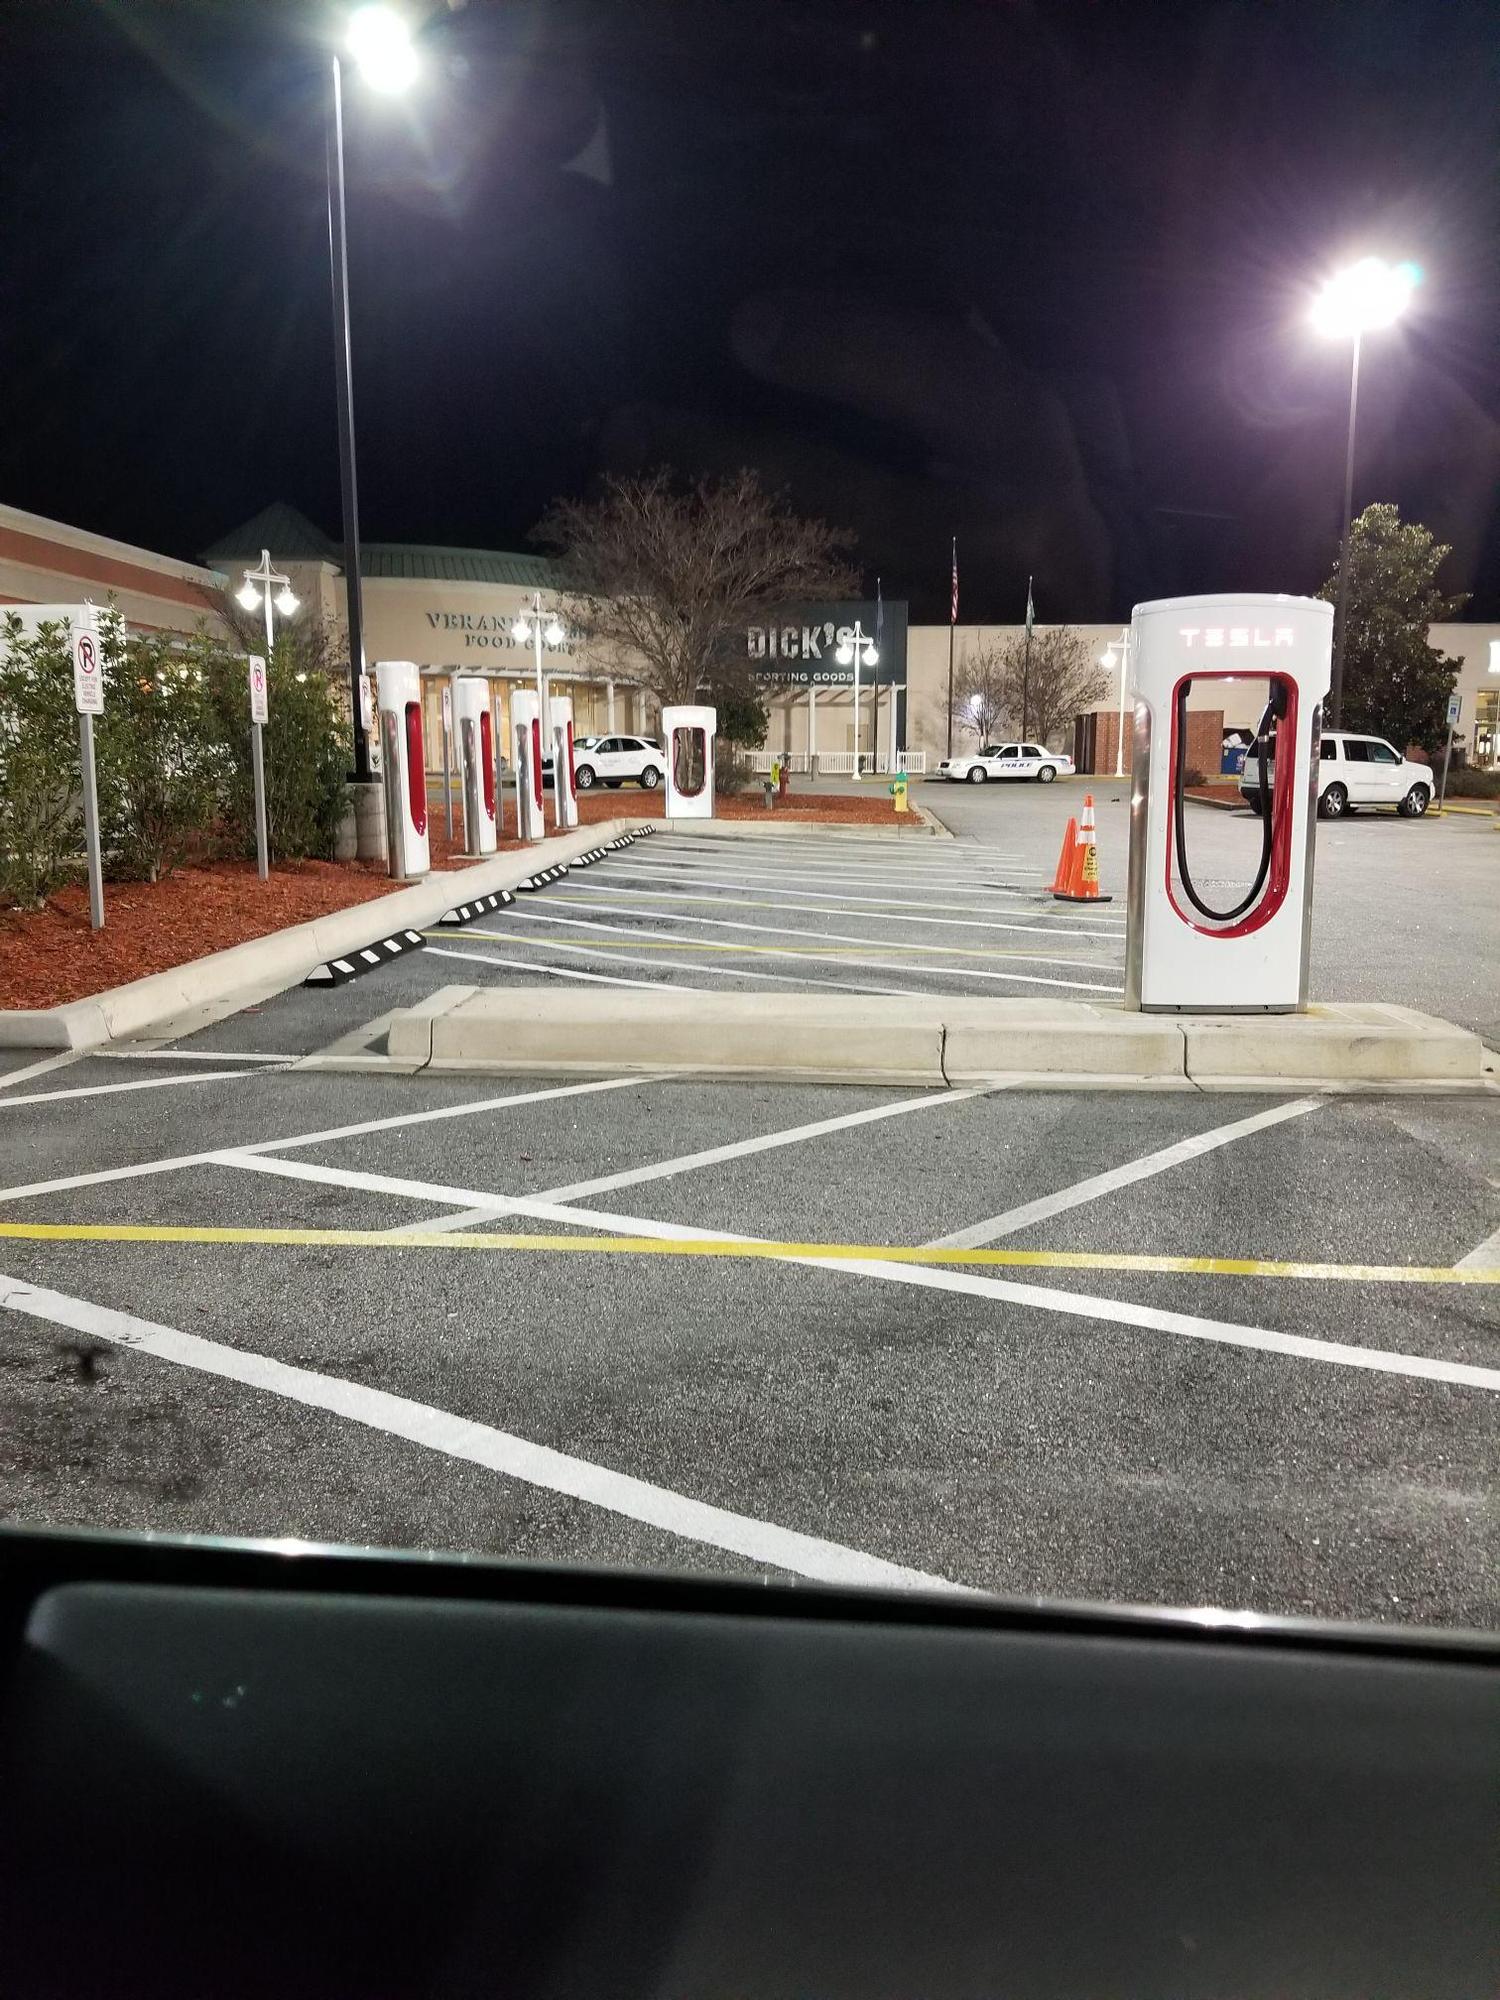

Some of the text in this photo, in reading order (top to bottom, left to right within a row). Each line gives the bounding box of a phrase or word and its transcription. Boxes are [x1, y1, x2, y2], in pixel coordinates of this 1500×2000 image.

[464, 633, 516, 649] FOOD
[747, 622, 854, 661] DICK'S
[1179, 627, 1295, 648] TESLA
[813, 672, 854, 681] GOODS
